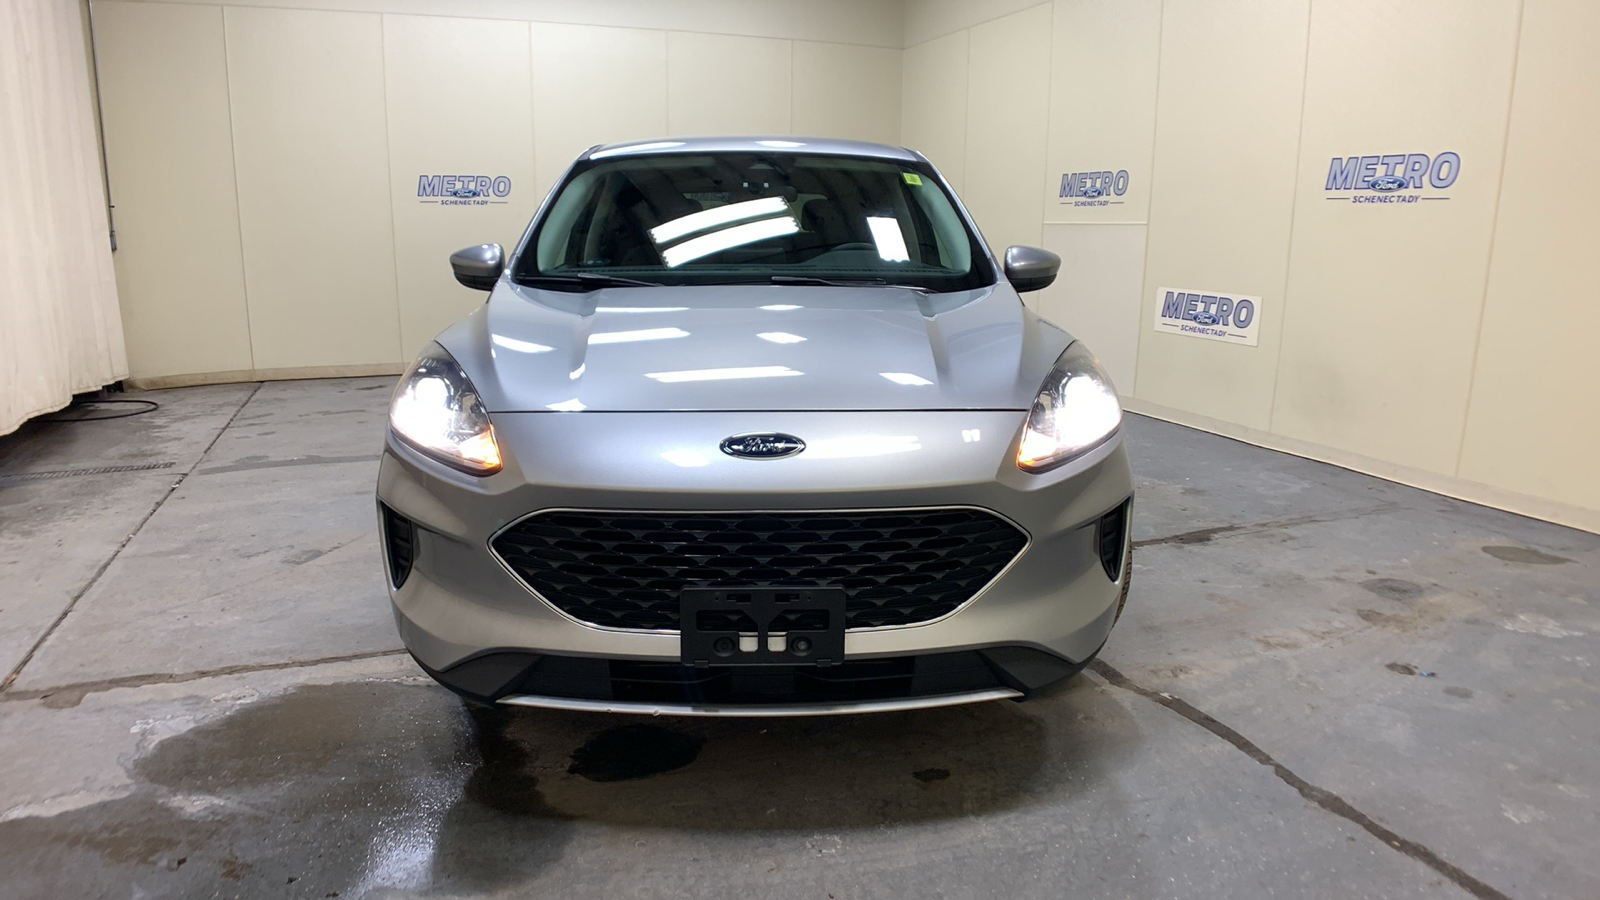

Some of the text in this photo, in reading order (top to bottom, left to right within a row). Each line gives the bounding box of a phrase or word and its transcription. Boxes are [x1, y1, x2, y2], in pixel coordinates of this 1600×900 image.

[1325, 152, 1461, 190] METRO
[417, 175, 512, 197] METRO
[1059, 170, 1129, 198] METRO
[1352, 195, 1421, 204] SCHENECTADY
[1161, 291, 1254, 329] METRO
[1180, 324, 1227, 337] SCHENECTADY
[739, 436, 787, 453] Ford
